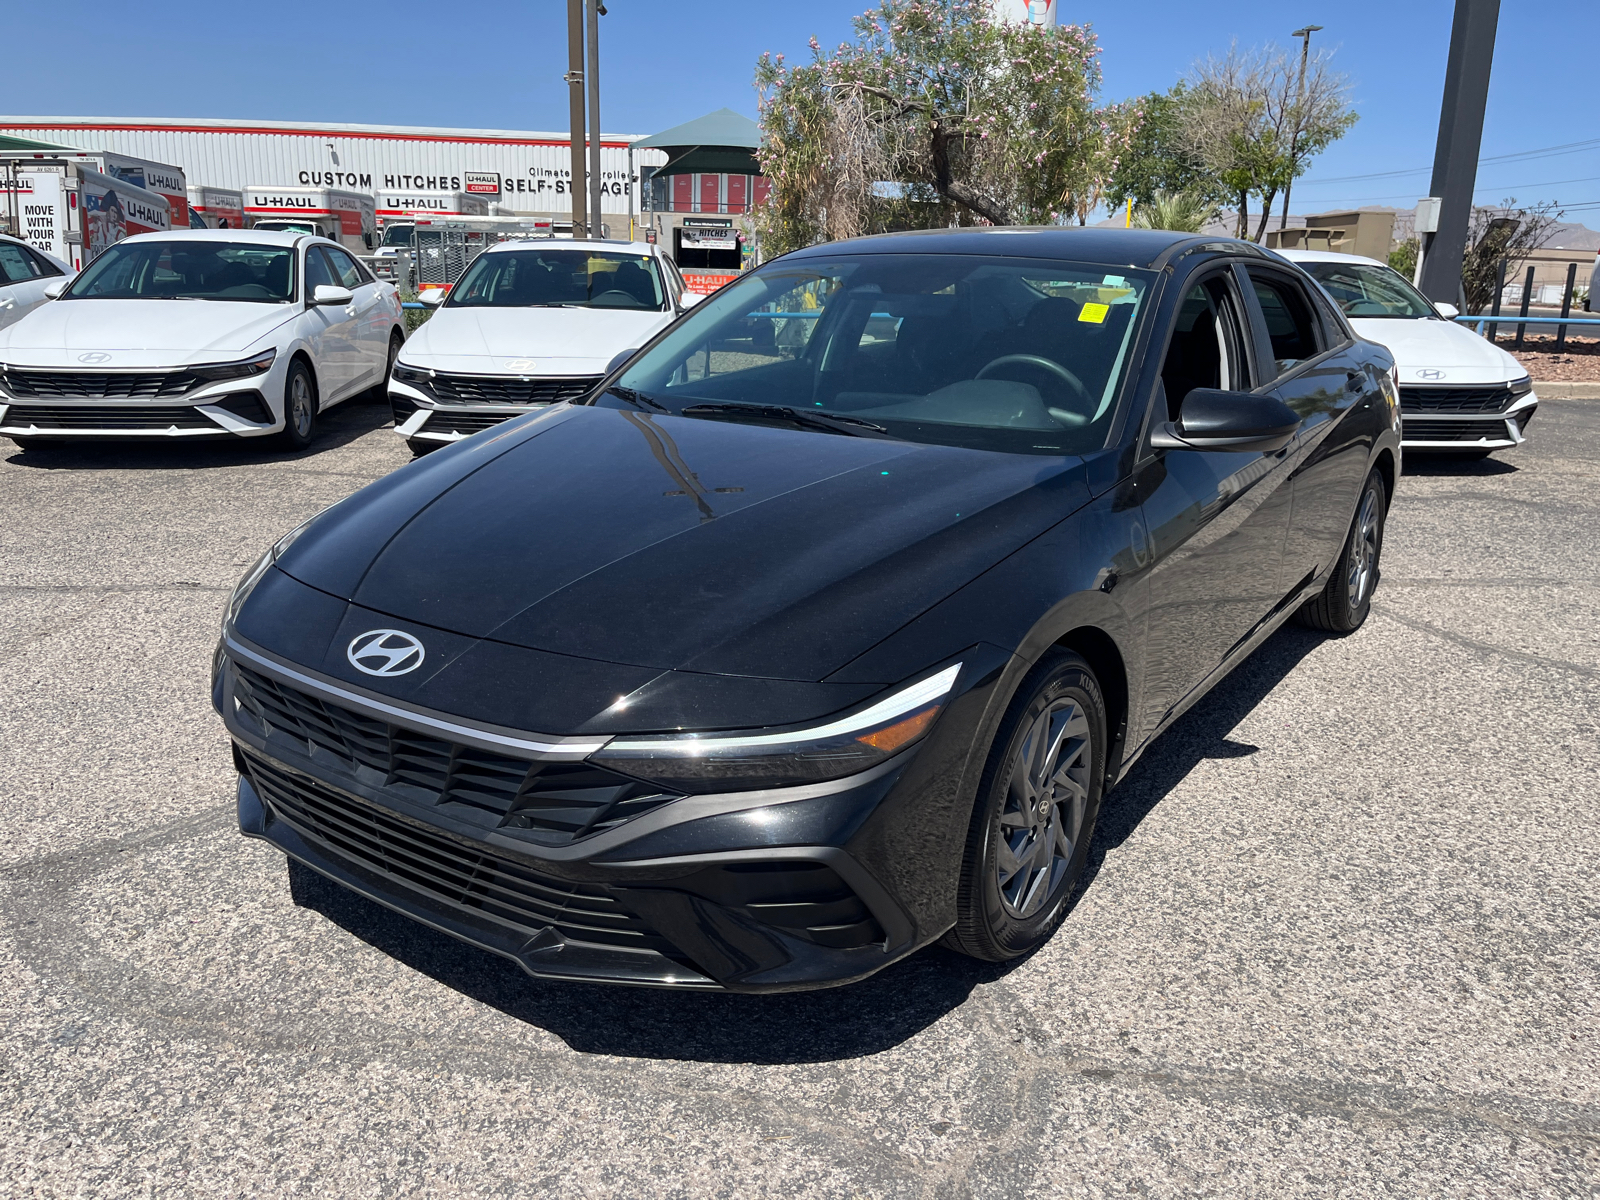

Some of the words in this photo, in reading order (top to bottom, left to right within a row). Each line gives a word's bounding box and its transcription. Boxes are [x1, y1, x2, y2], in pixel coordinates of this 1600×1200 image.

[529, 166, 570, 178] Climate
[148, 173, 182, 191] U-HAUL
[298, 171, 372, 189] CUSTOM
[384, 174, 461, 191] HITCHES
[467, 175, 497, 183] U-HAUL
[214, 196, 238, 207] U-HAUL
[255, 196, 317, 208] U-HAUL
[387, 198, 448, 209] U-HAUL
[25, 205, 54, 215] MOVE
[127, 201, 165, 227] U-HAUL
[26, 217, 53, 227] WITH
[27, 229, 55, 240] YOUR
[699, 229, 728, 238] HITCHES
[1078, 673, 1103, 718] KUMHO
